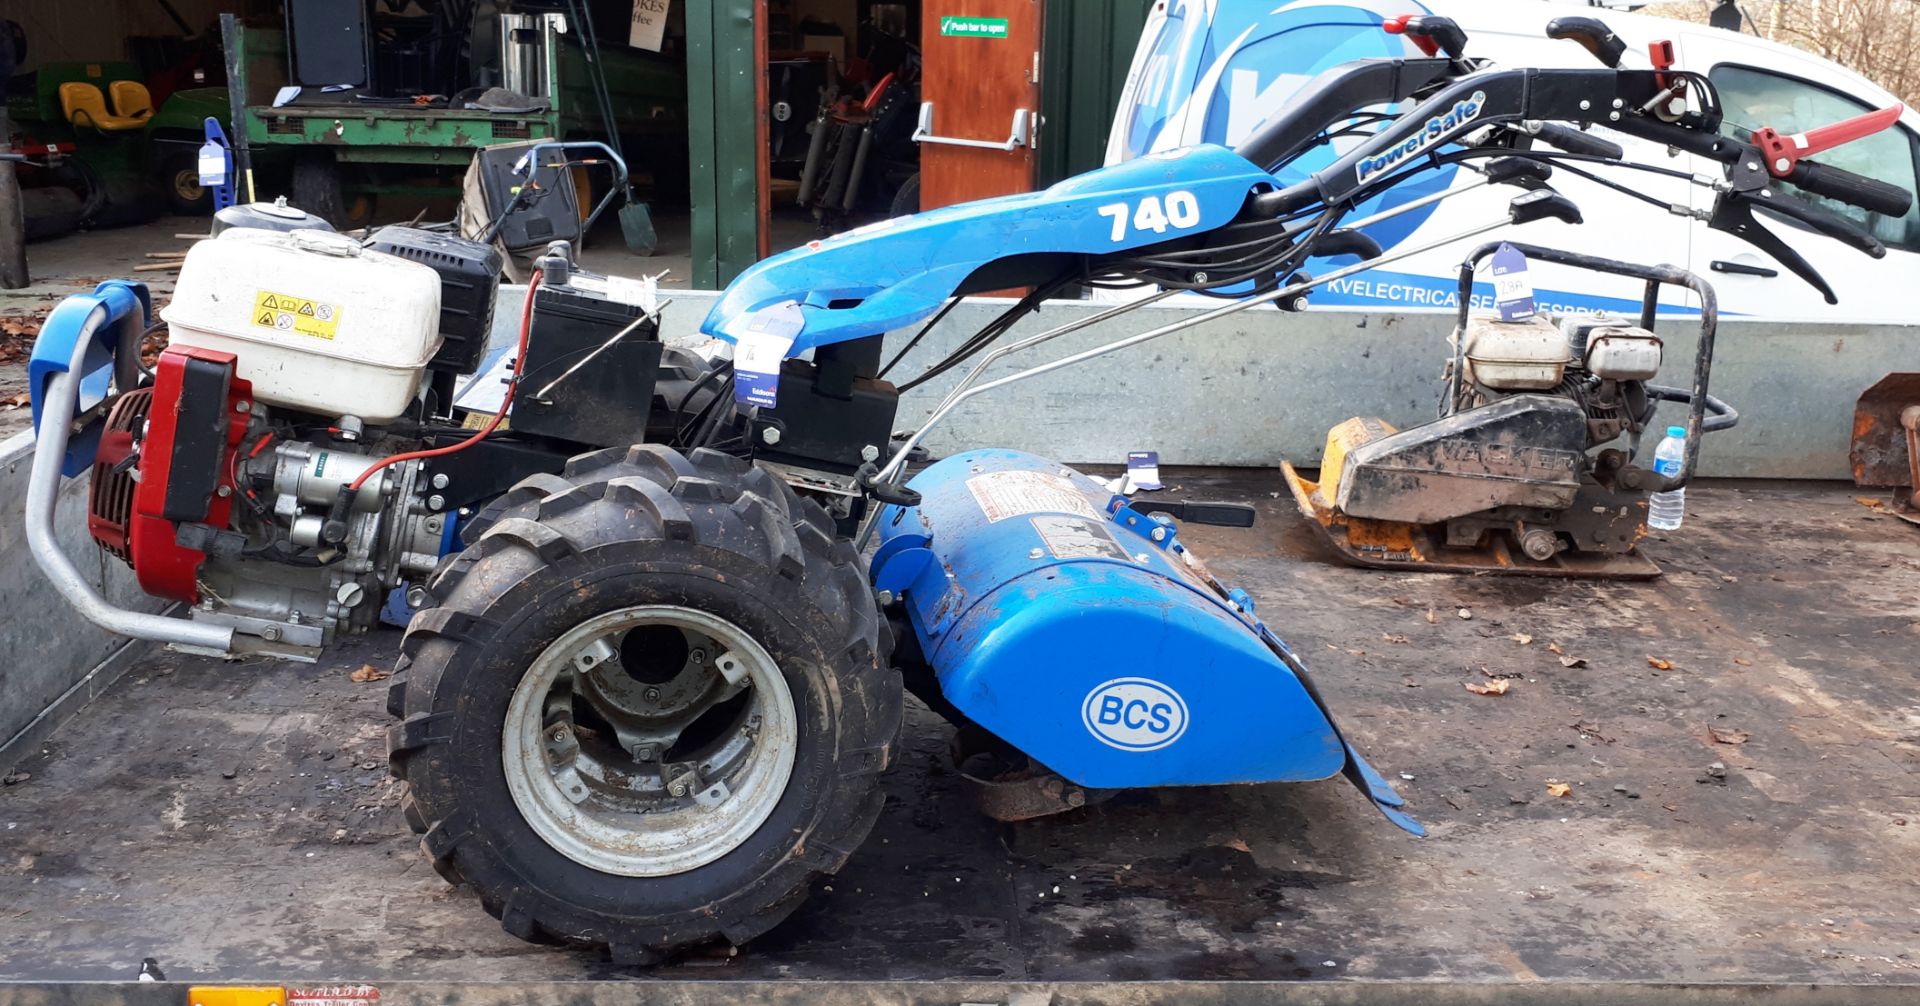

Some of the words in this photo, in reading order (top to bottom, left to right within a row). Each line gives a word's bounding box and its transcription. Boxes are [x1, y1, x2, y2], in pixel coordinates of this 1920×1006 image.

[951, 22, 968, 31] Push
[968, 23, 980, 32] bar
[980, 23, 988, 32] to
[988, 25, 1006, 34] open
[1097, 190, 1200, 242] 740
[1098, 694, 1172, 733] BCS
